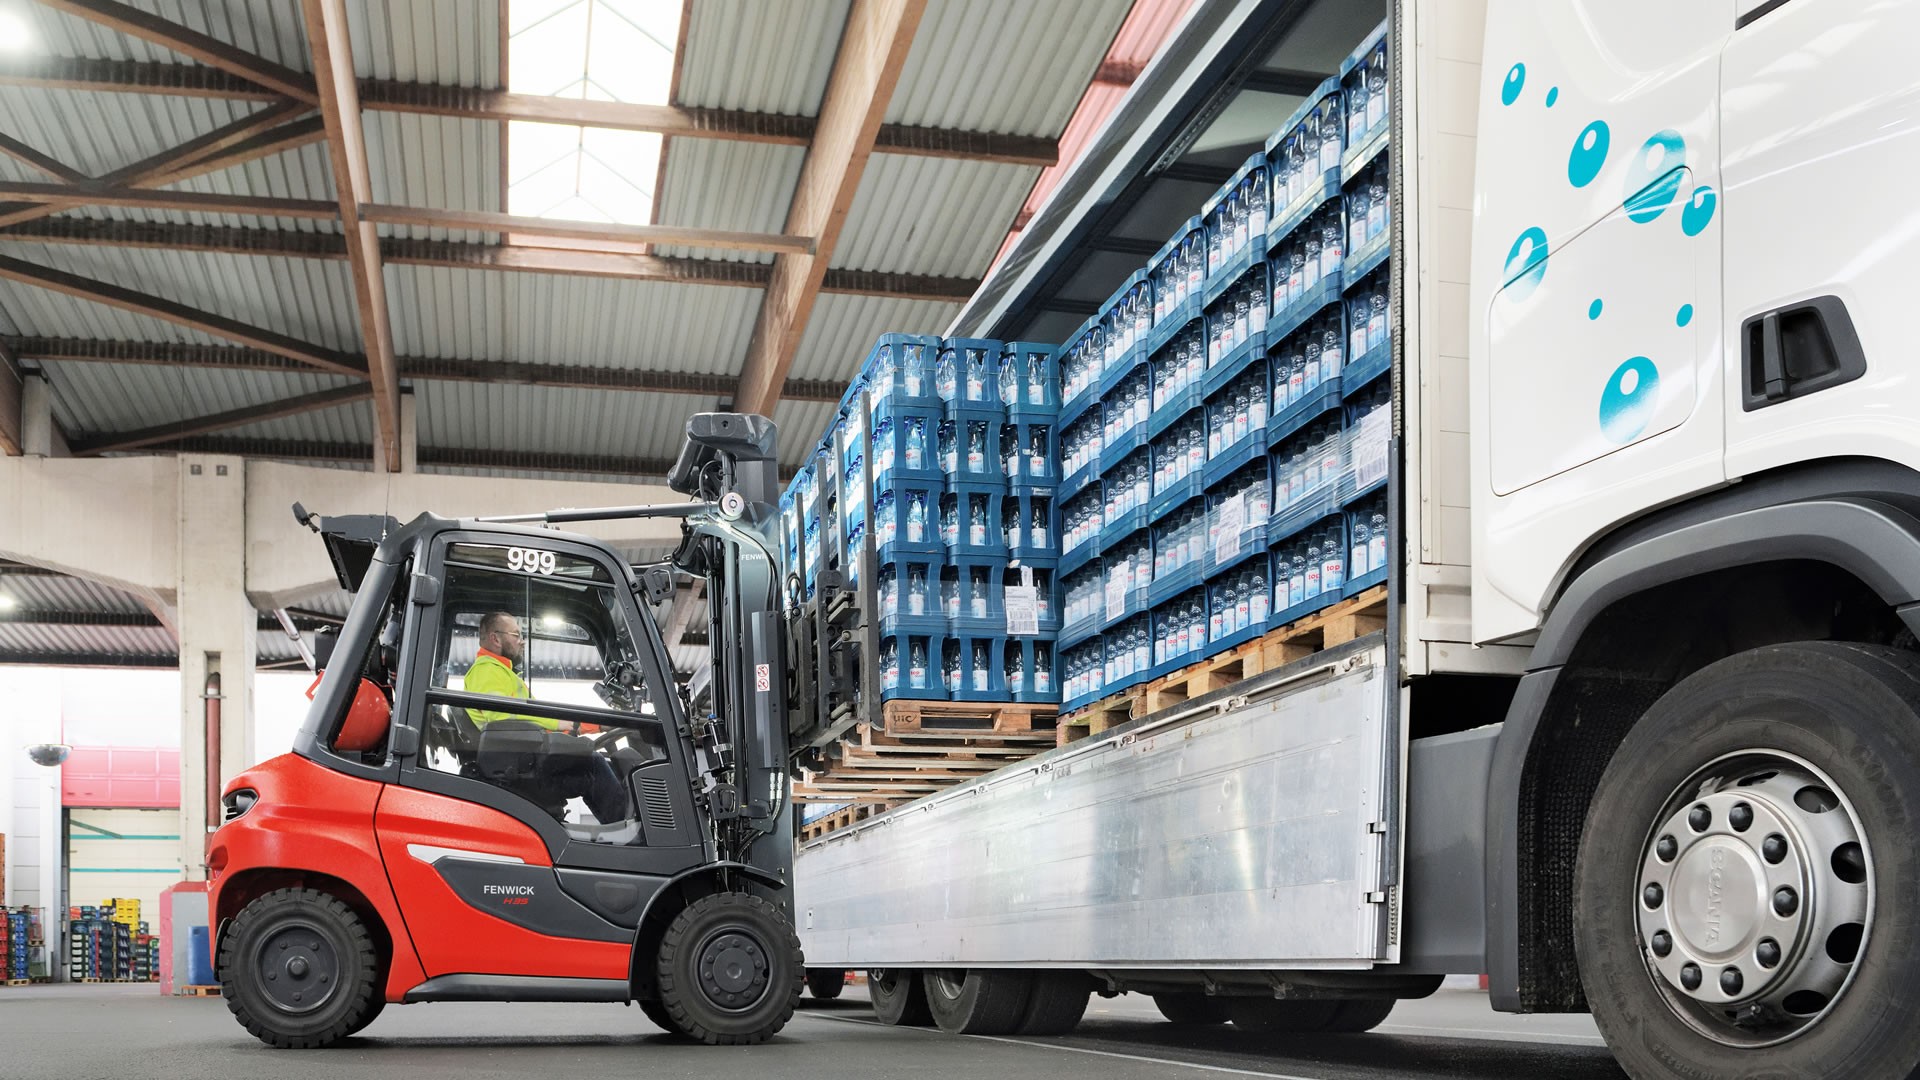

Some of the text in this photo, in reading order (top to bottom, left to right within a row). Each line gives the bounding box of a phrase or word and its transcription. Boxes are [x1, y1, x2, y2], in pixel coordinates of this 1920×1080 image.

[507, 547, 556, 575] 999
[483, 885, 535, 895] FENWICK
[1705, 848, 1722, 947] SCANIA
